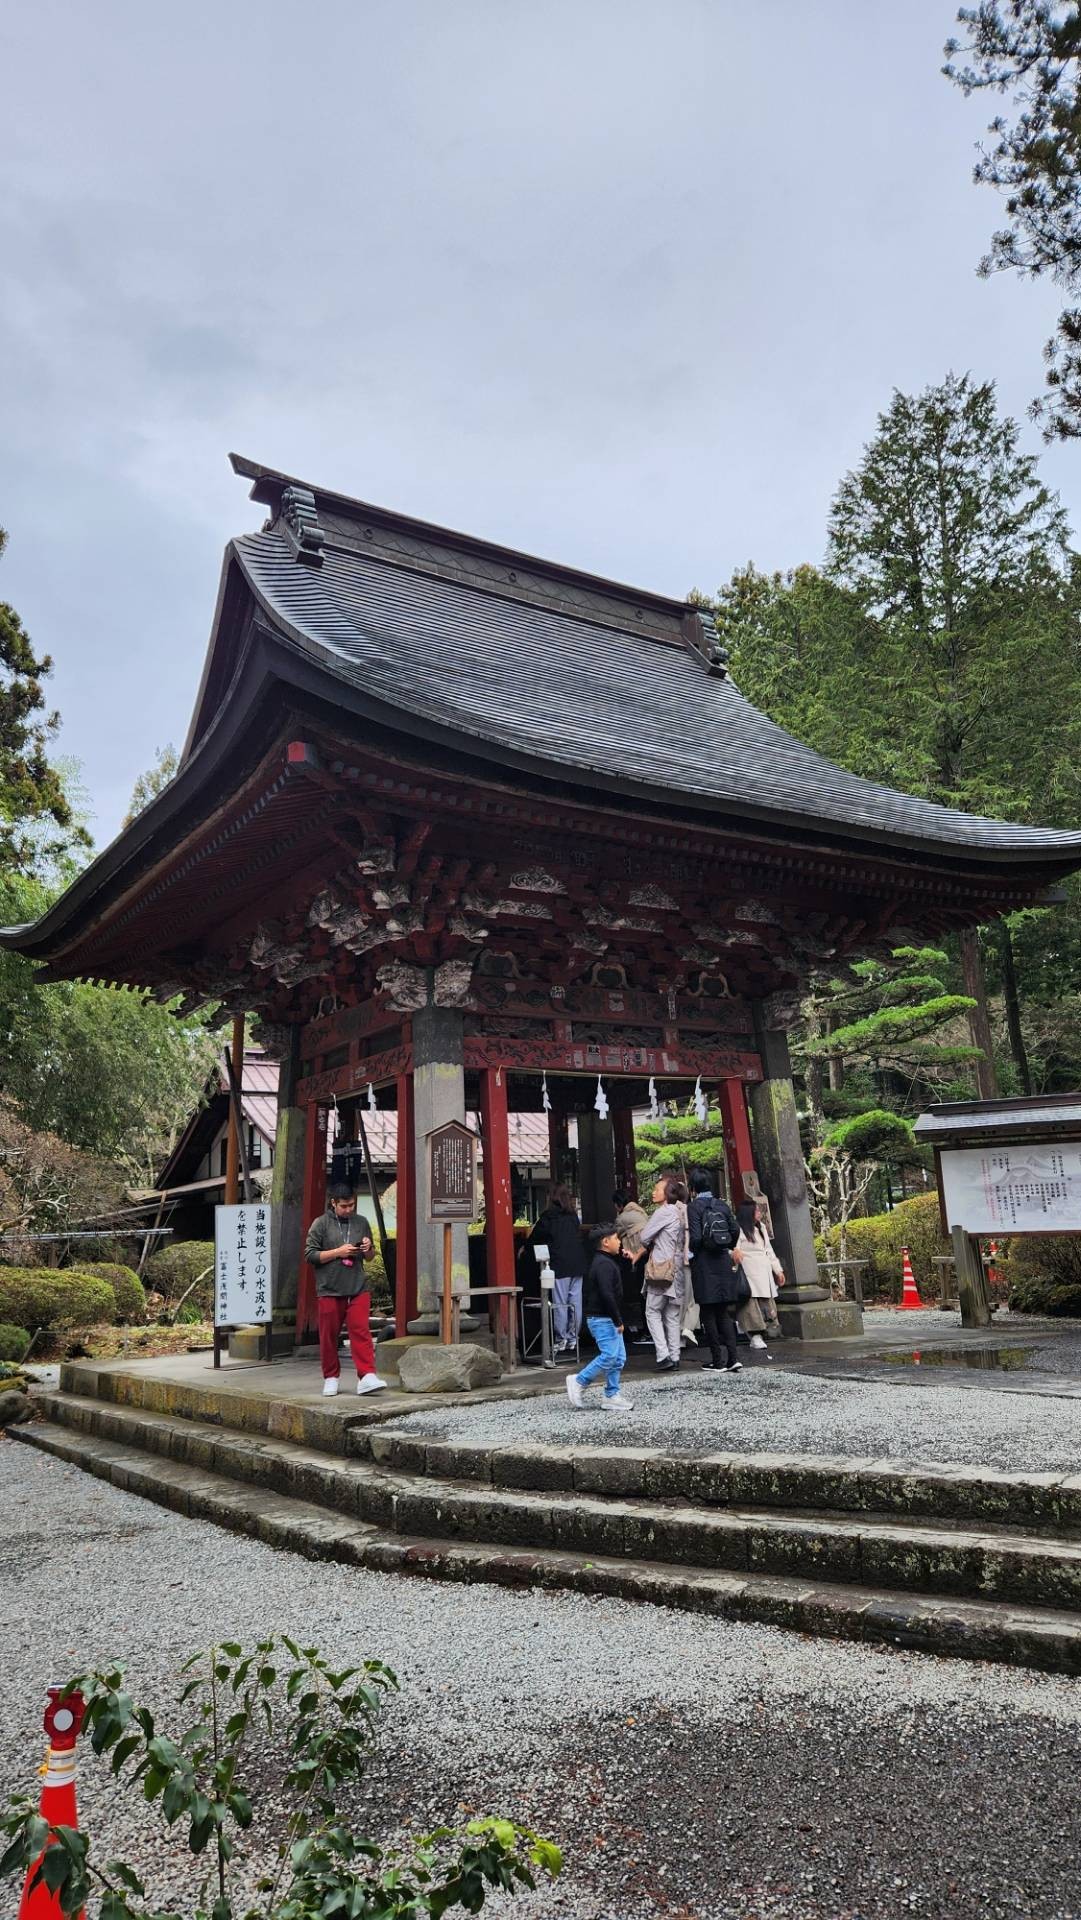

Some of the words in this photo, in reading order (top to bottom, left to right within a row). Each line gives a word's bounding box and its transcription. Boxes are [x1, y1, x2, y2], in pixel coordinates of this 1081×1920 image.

[236, 1210, 249, 1295] を禁止します。
[255, 1209, 267, 1317] 当施設での水汲み
